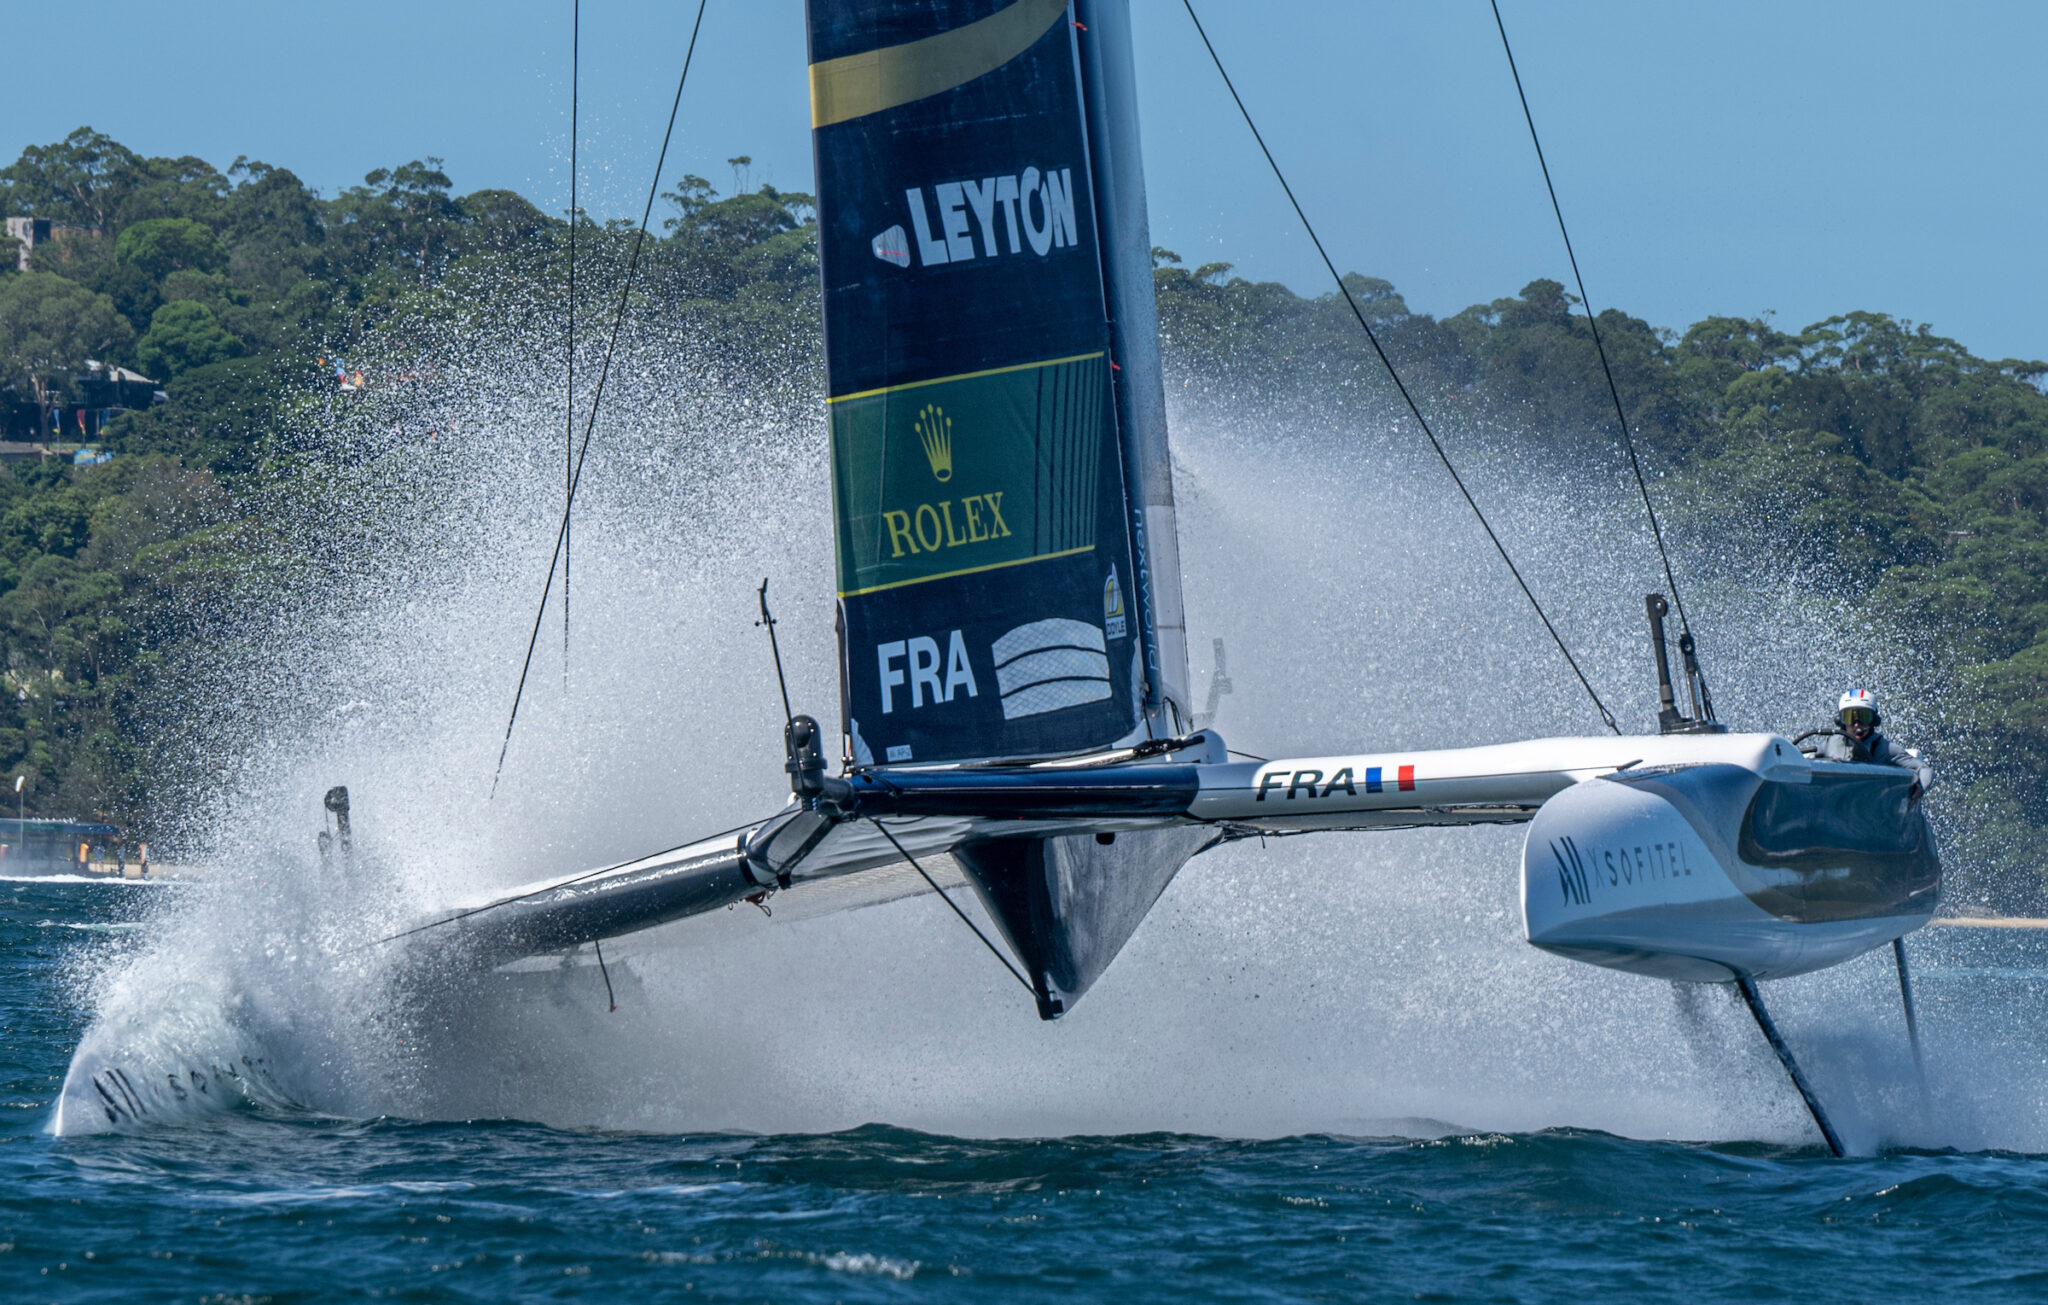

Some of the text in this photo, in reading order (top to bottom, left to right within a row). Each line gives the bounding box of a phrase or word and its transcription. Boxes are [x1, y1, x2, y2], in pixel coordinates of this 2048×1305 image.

[906, 166, 1078, 266] LEYTON
[882, 492, 1012, 558] ROLEX
[1105, 620, 1125, 635] DOYLE
[877, 629, 979, 715] FRA
[1256, 767, 1357, 802] FRA
[1604, 841, 1692, 887] SOFITEL
